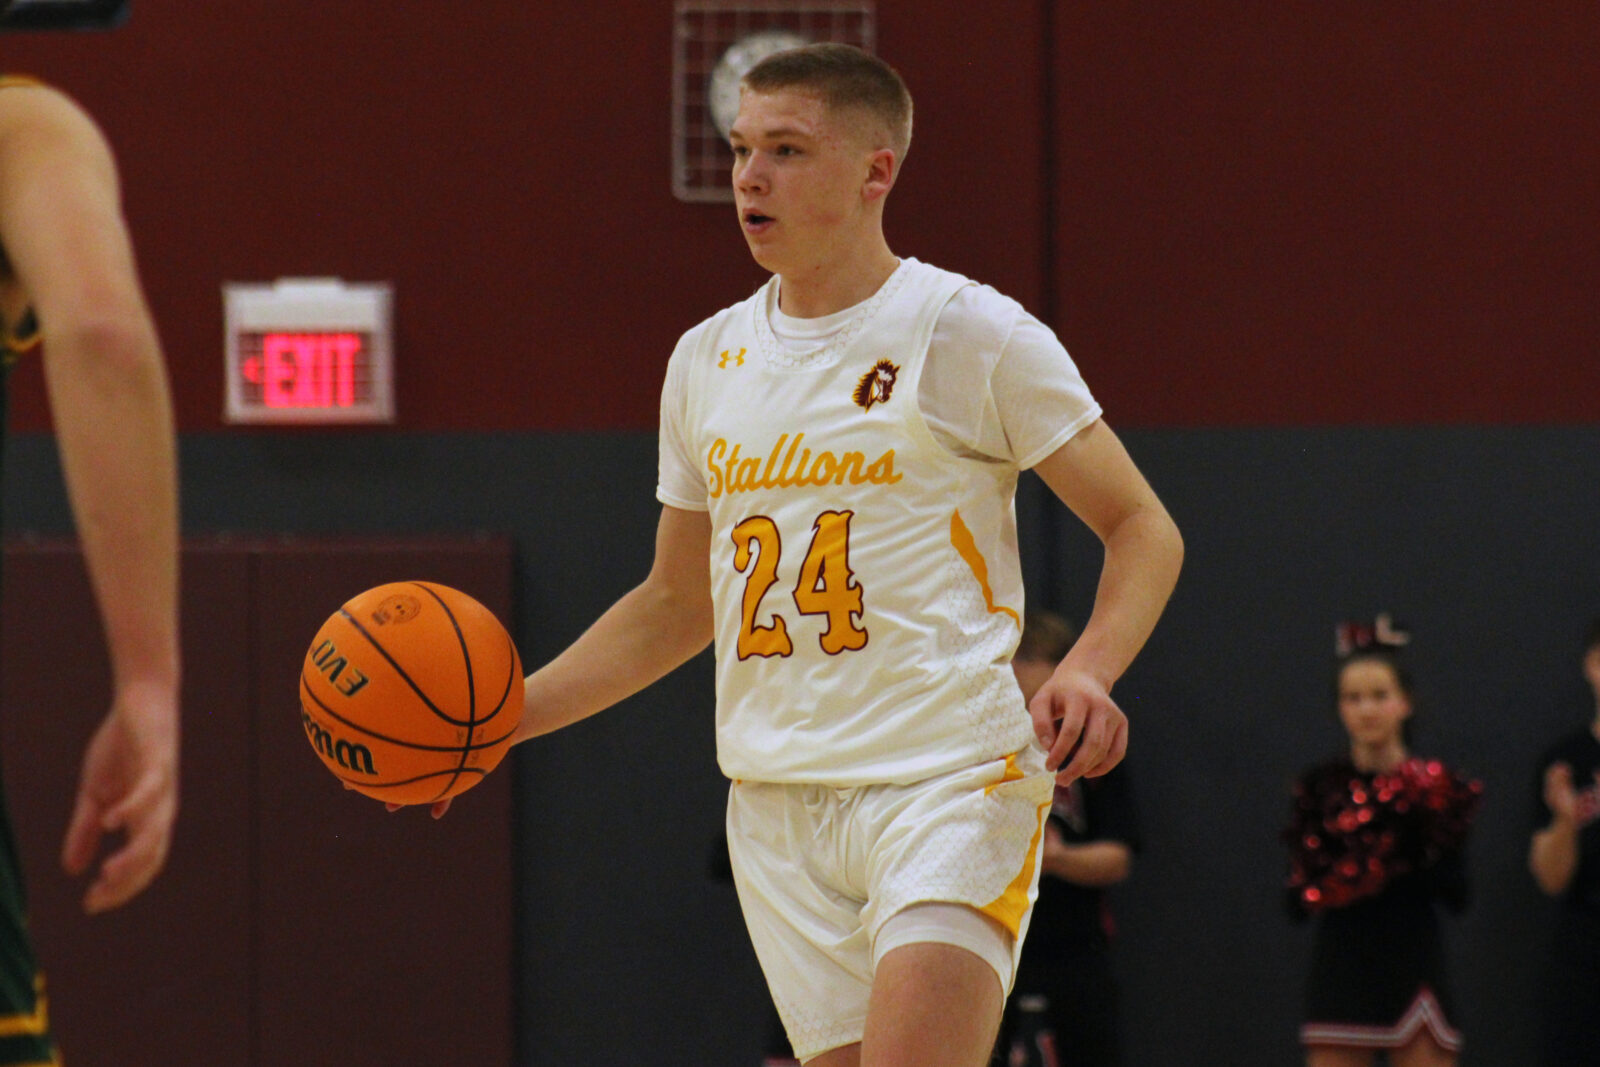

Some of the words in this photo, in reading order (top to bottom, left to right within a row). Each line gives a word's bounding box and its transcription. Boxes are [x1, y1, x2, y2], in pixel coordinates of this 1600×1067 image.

[263, 333, 361, 408] EXIT
[707, 433, 903, 498] Stallions
[731, 510, 868, 661] 24
